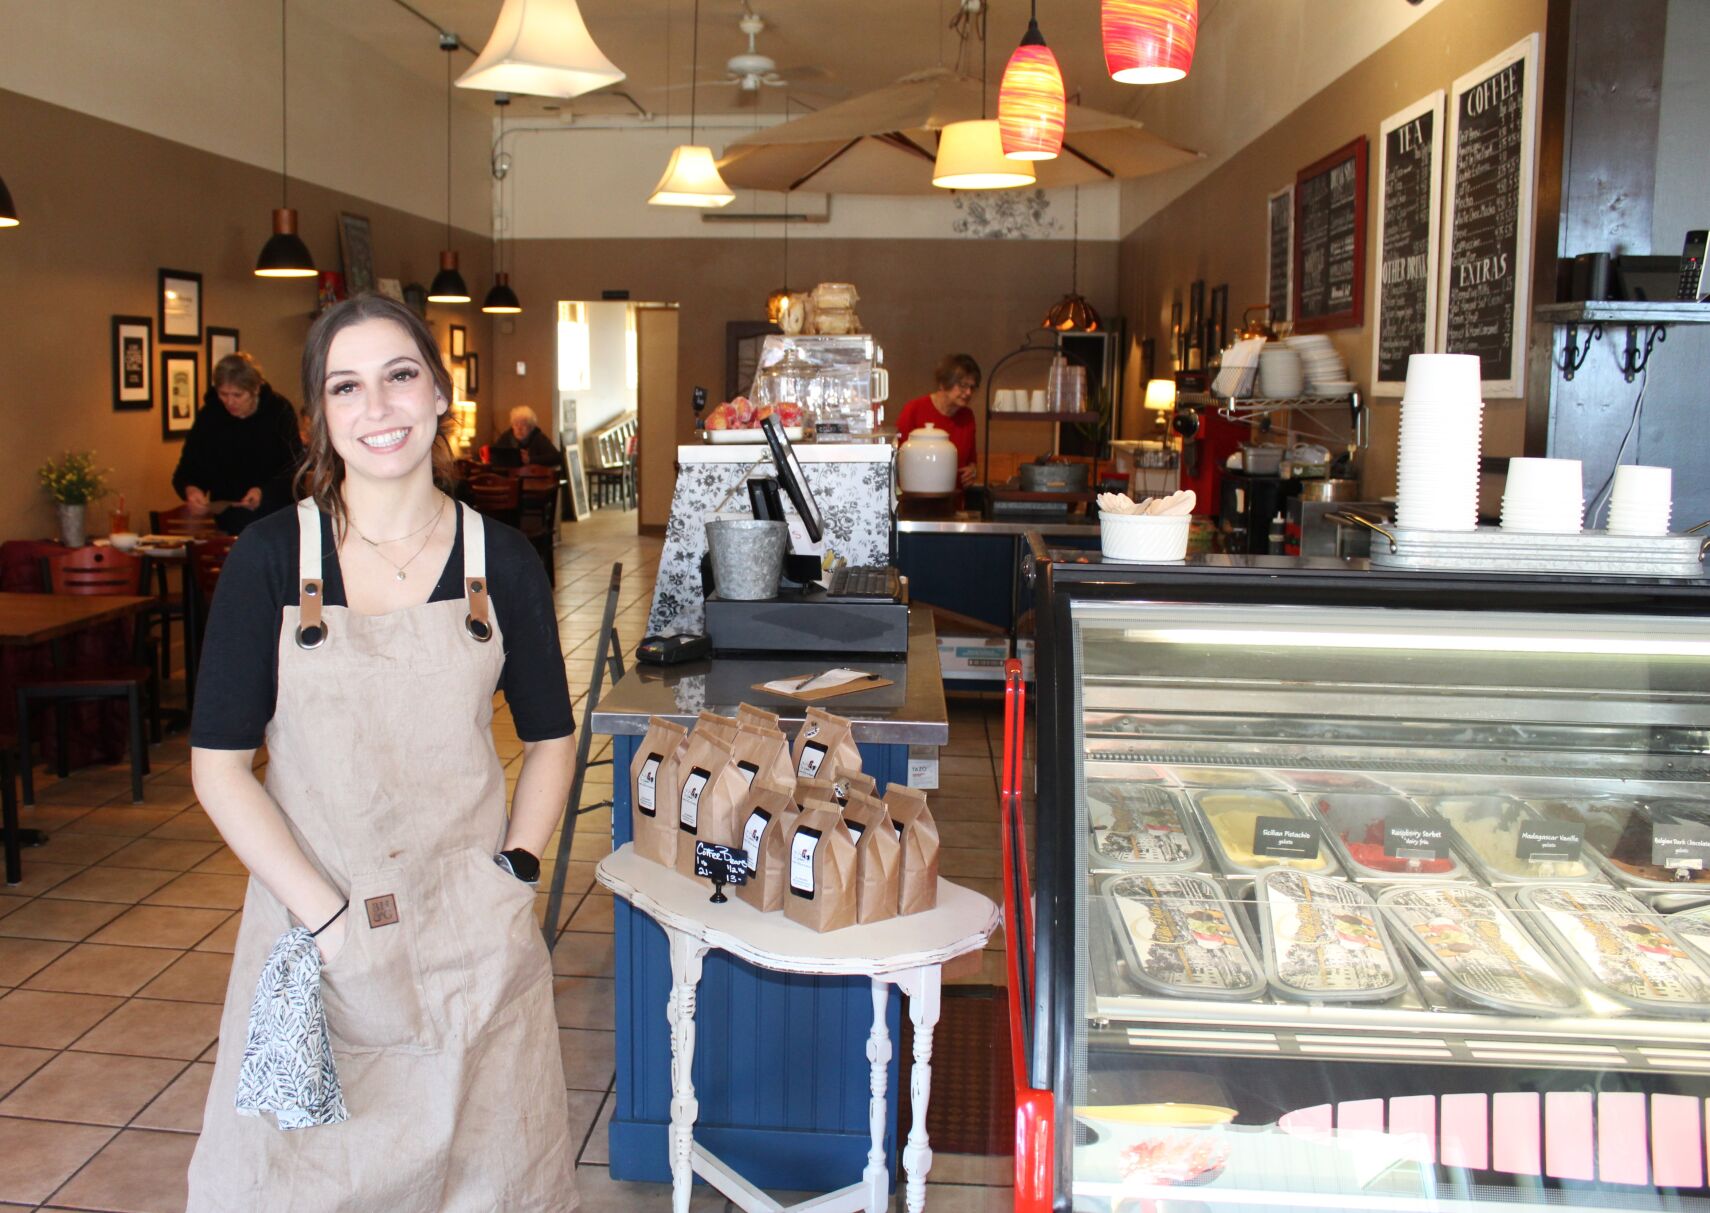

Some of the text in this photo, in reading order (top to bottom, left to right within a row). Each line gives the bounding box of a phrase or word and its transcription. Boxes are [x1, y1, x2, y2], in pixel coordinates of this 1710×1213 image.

[1467, 65, 1518, 117] COFFEE
[1399, 120, 1422, 154] TEA
[1382, 257, 1405, 284] OTHER
[1459, 252, 1508, 287] EXTRAS
[1284, 830, 1311, 839] Pistachio
[1391, 829, 1441, 839] Raspberry Sorbet
[1522, 832, 1579, 842] Madagascar Vanilla
[1654, 837, 1672, 846] Belgian
[697, 842, 723, 861] Coffee
